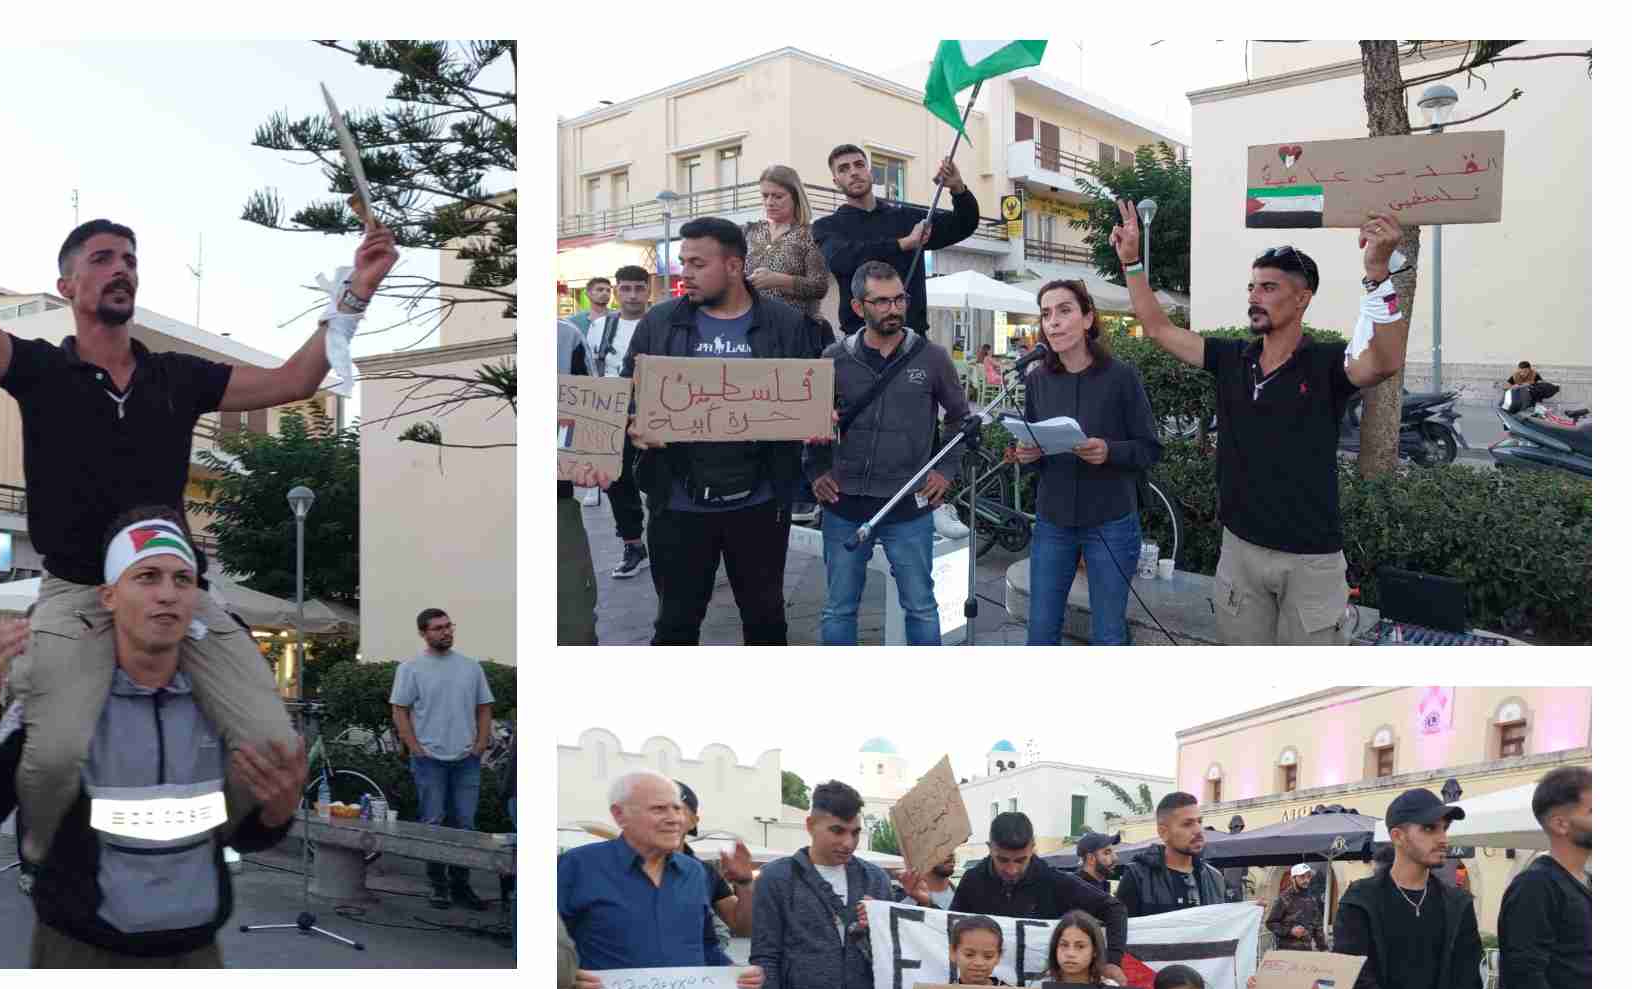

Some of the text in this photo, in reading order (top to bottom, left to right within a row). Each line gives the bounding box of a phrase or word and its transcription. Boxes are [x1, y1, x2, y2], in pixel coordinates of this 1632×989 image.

[559, 384, 628, 413] ESTINE
[660, 363, 815, 412] فلسطين
[726, 409, 801, 435] حرة
